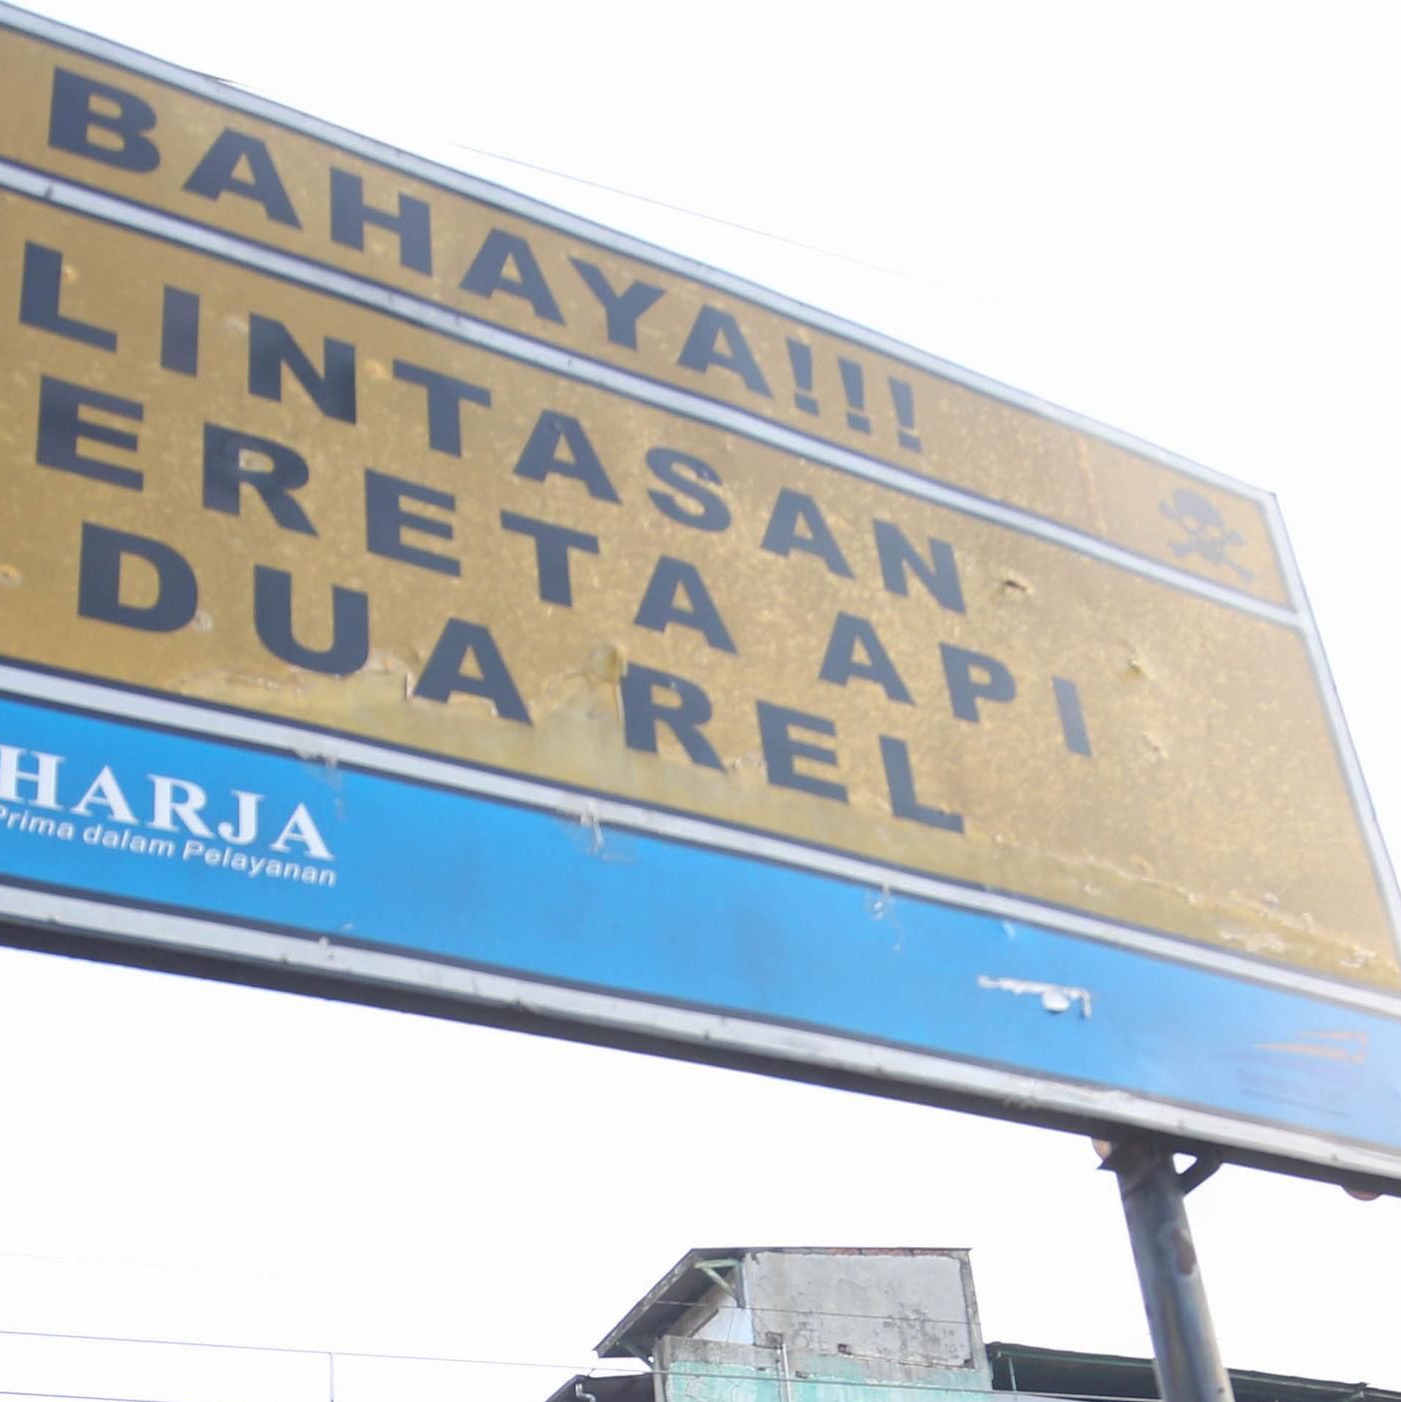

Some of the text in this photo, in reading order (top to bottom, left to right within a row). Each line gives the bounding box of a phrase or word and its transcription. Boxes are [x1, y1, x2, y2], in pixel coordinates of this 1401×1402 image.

[47, 66, 922, 453] BAHAYA!!!
[18, 240, 967, 614] LINTASAN
[77, 521, 965, 836] DUA REL
[818, 611, 1093, 758] API
[83, 823, 174, 859] dalam
[182, 839, 337, 888] Pelayanan
